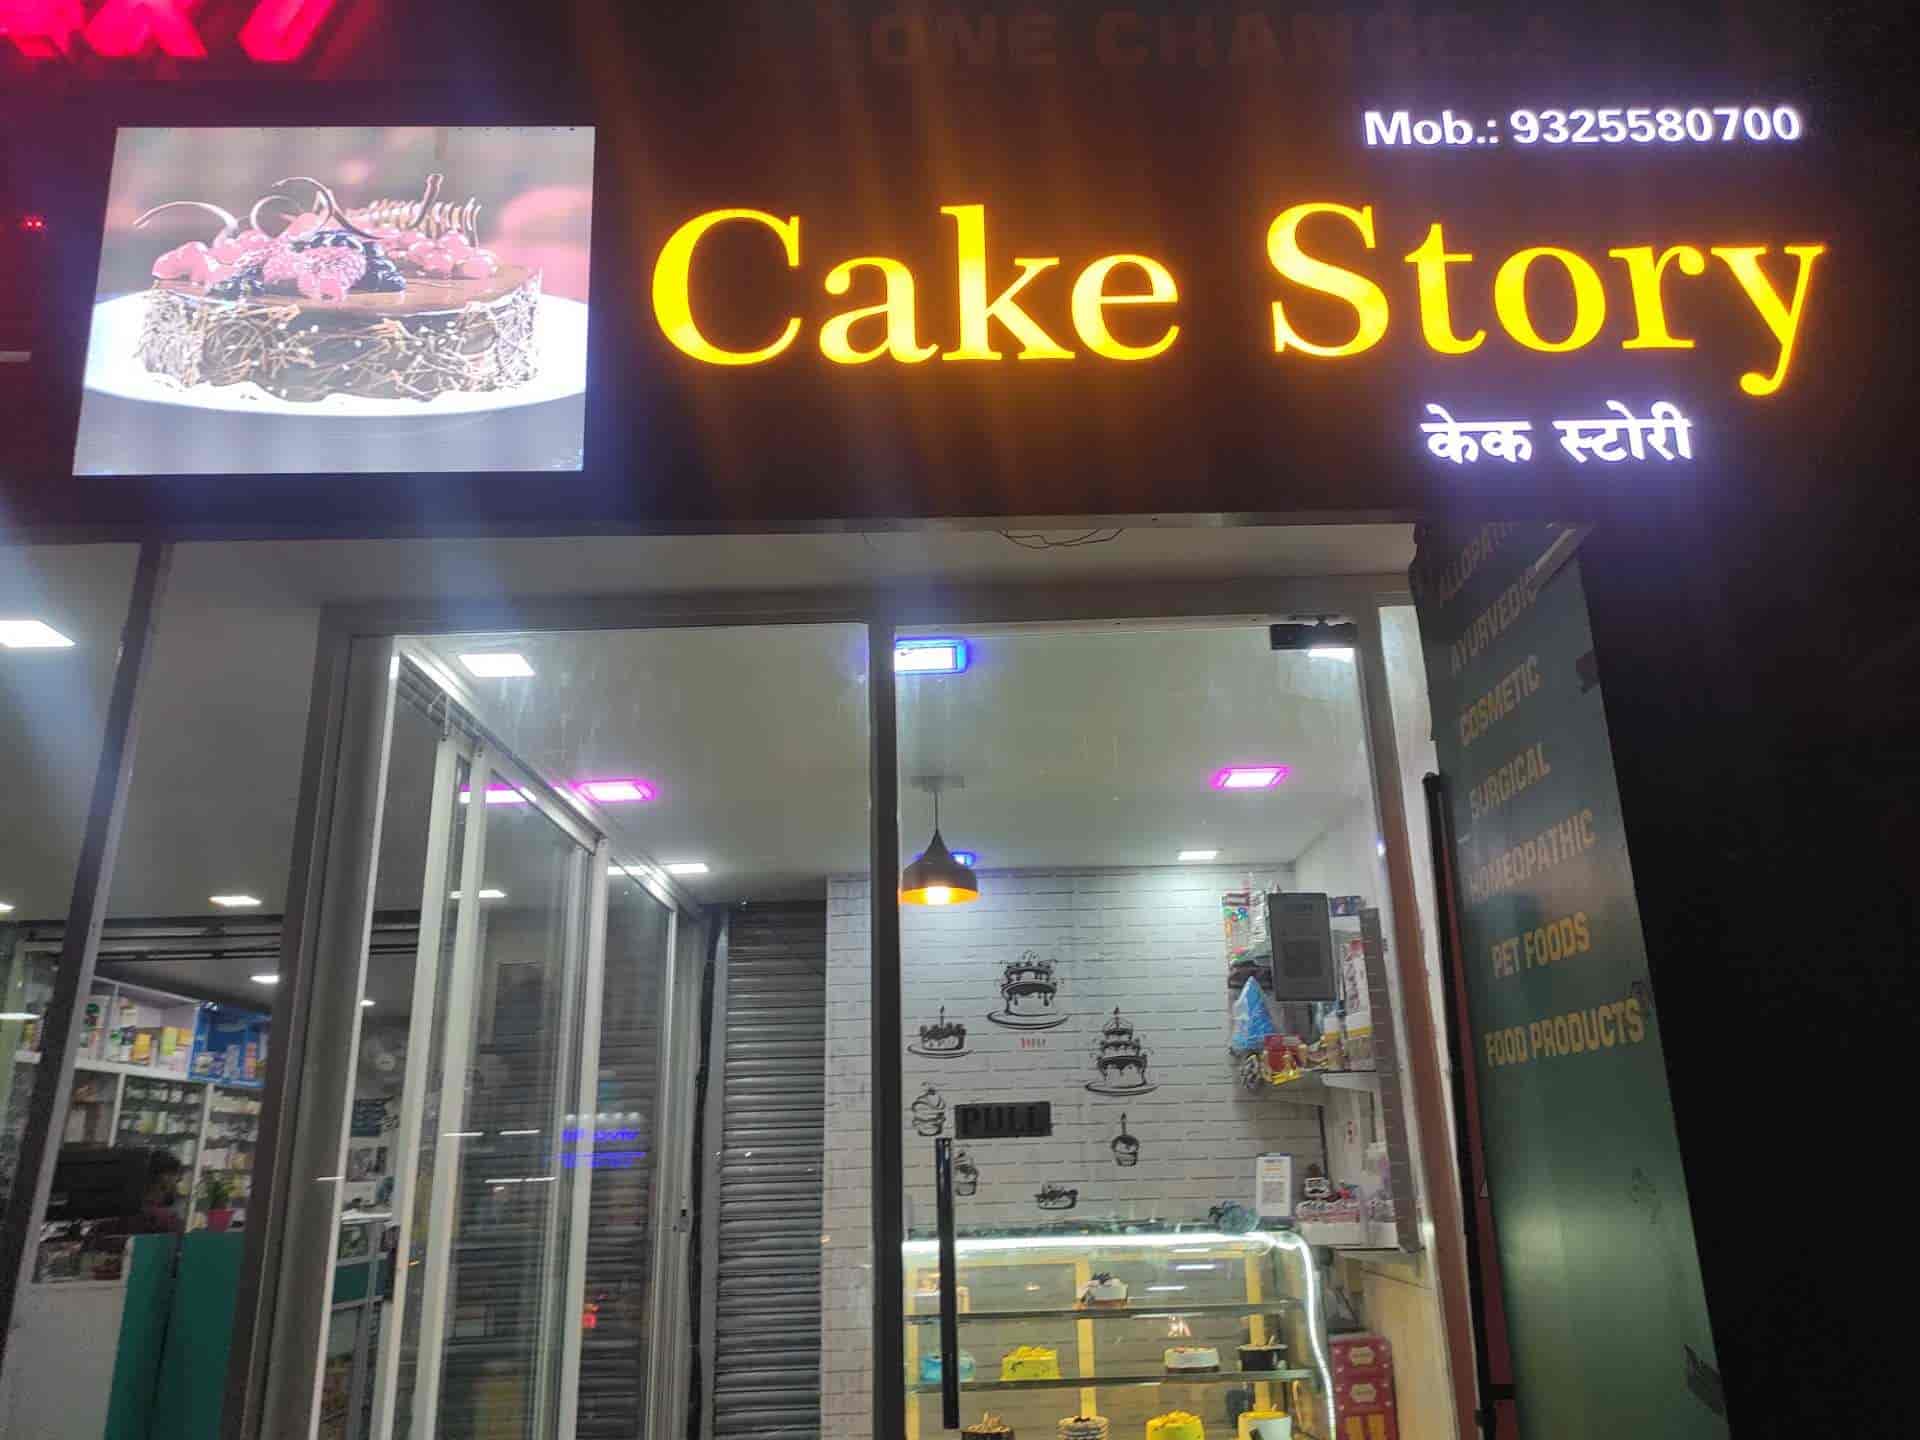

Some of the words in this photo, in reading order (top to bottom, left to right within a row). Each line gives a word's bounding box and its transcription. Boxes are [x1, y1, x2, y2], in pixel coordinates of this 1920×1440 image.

[1363, 109, 1500, 146] Mob.:
[1509, 106, 1802, 144] 9325580700
[651, 203, 1181, 367] Cake
[1265, 202, 1826, 397] Story
[1419, 402, 1534, 465] केक
[1550, 398, 1694, 464] स्टोरी
[1459, 654, 1544, 747] COSMETIC
[1468, 741, 1551, 820] SURGICAL
[1468, 808, 1596, 904] HOMEOPATHIC
[1490, 937, 1521, 979] PET
[1523, 912, 1592, 969] FOODS
[1484, 1025, 1528, 1067] FOOD
[1530, 998, 1645, 1059] PRODUCTS
